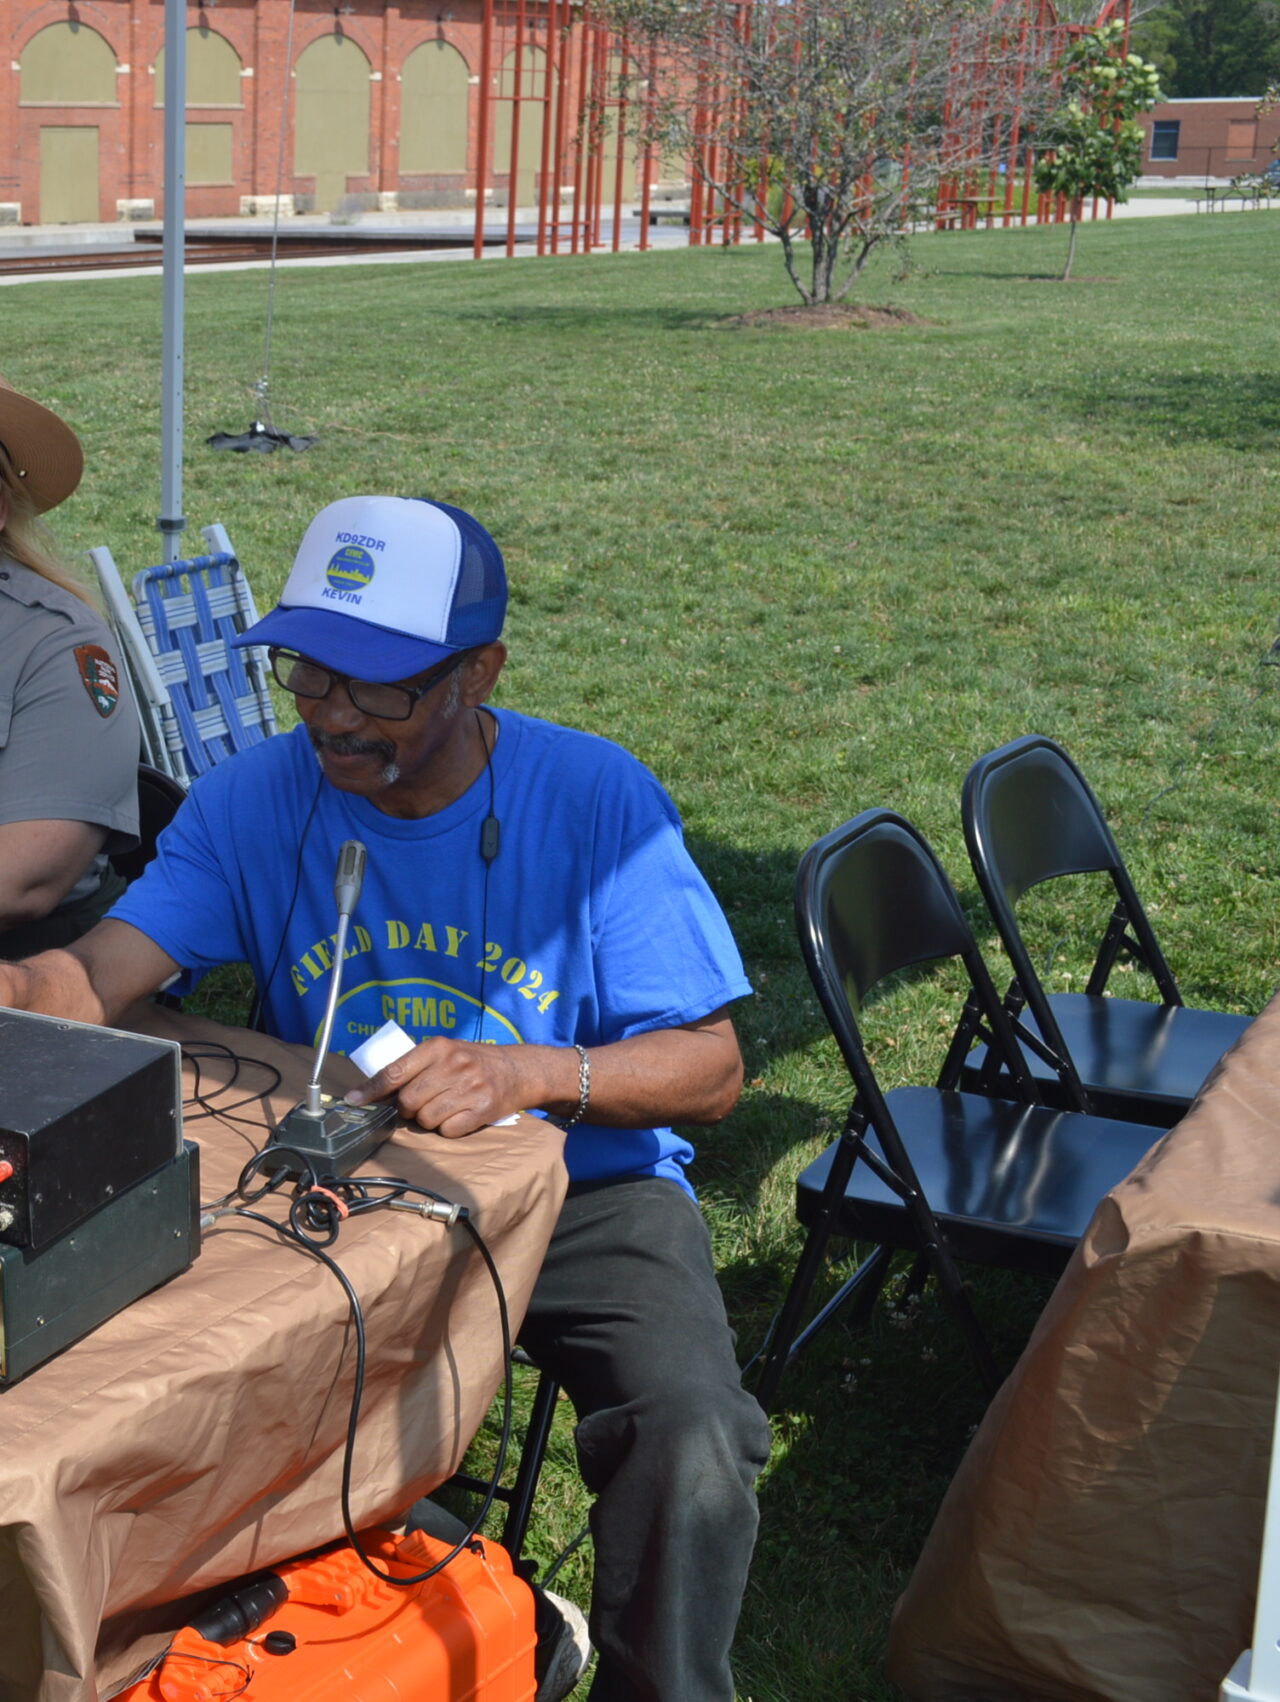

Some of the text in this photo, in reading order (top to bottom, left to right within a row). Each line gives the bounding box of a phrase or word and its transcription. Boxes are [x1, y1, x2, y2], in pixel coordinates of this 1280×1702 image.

[336, 532, 386, 552] KD9ZDR
[321, 587, 362, 605] KEVIN
[385, 920, 468, 958] DAY
[475, 942, 560, 1014] 2024
[381, 994, 457, 1028] CFMC
